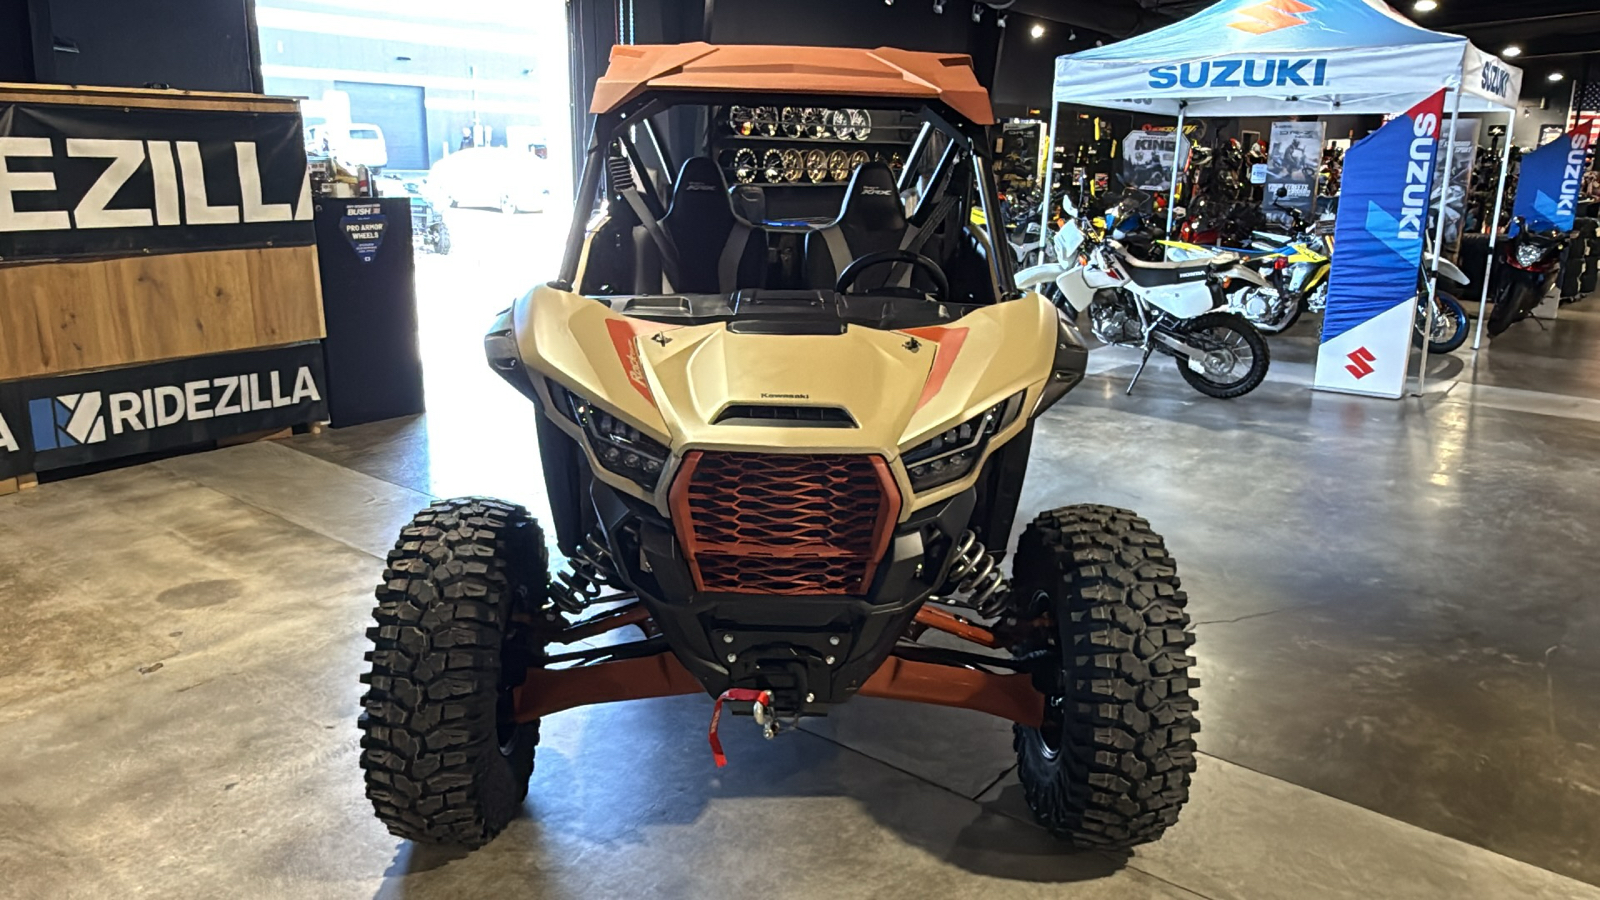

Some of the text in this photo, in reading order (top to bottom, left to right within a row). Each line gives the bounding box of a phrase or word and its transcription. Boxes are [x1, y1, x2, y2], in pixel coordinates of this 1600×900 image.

[1148, 58, 1327, 89] SUZUKI
[1481, 61, 1510, 98] SUZUKI
[1397, 112, 1437, 240] SUZUKI
[1556, 132, 1588, 216] SUZUKI
[346, 223, 384, 232] PRO ARMOR
[347, 208, 371, 216] BUSH
[352, 231, 379, 239] WHEELS
[1179, 270, 1206, 278] HONDA
[109, 366, 321, 434] RIDEZILLA
